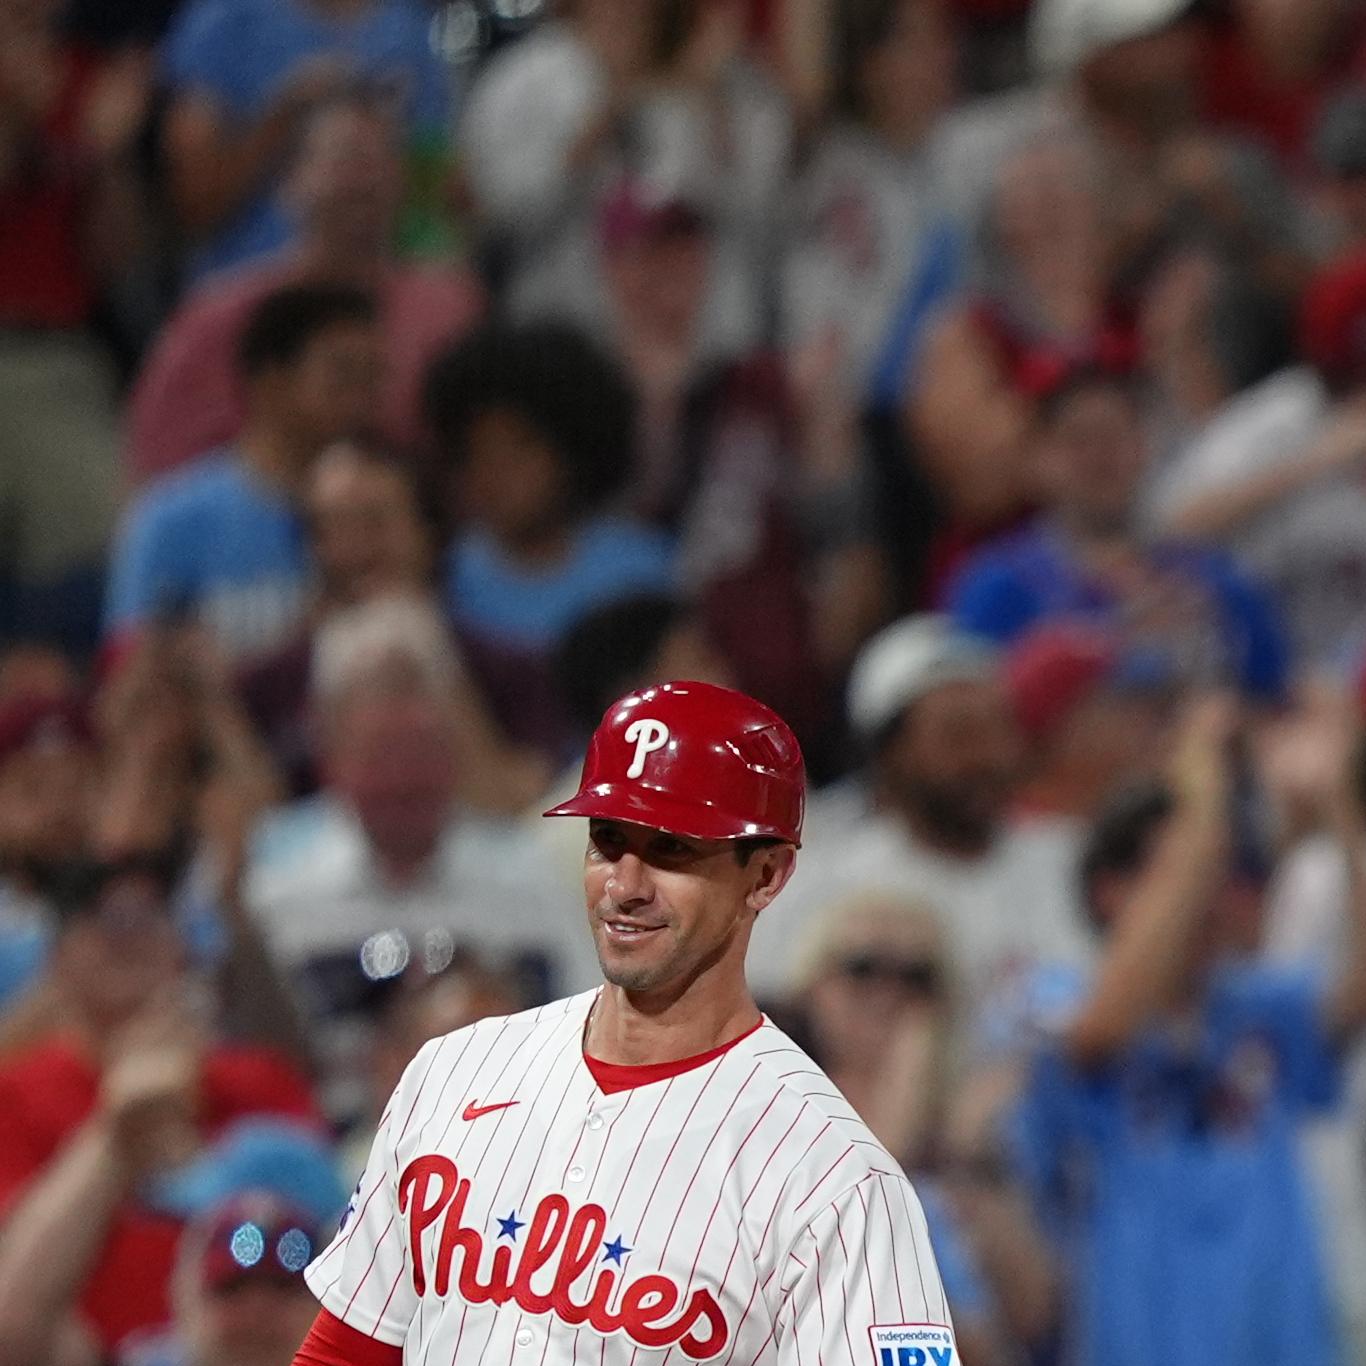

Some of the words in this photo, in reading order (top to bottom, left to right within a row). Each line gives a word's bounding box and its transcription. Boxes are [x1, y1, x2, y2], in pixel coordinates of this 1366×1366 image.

[624, 718, 669, 779] P
[397, 1152, 730, 1362] Phillies
[876, 1330, 942, 1343] Independence
